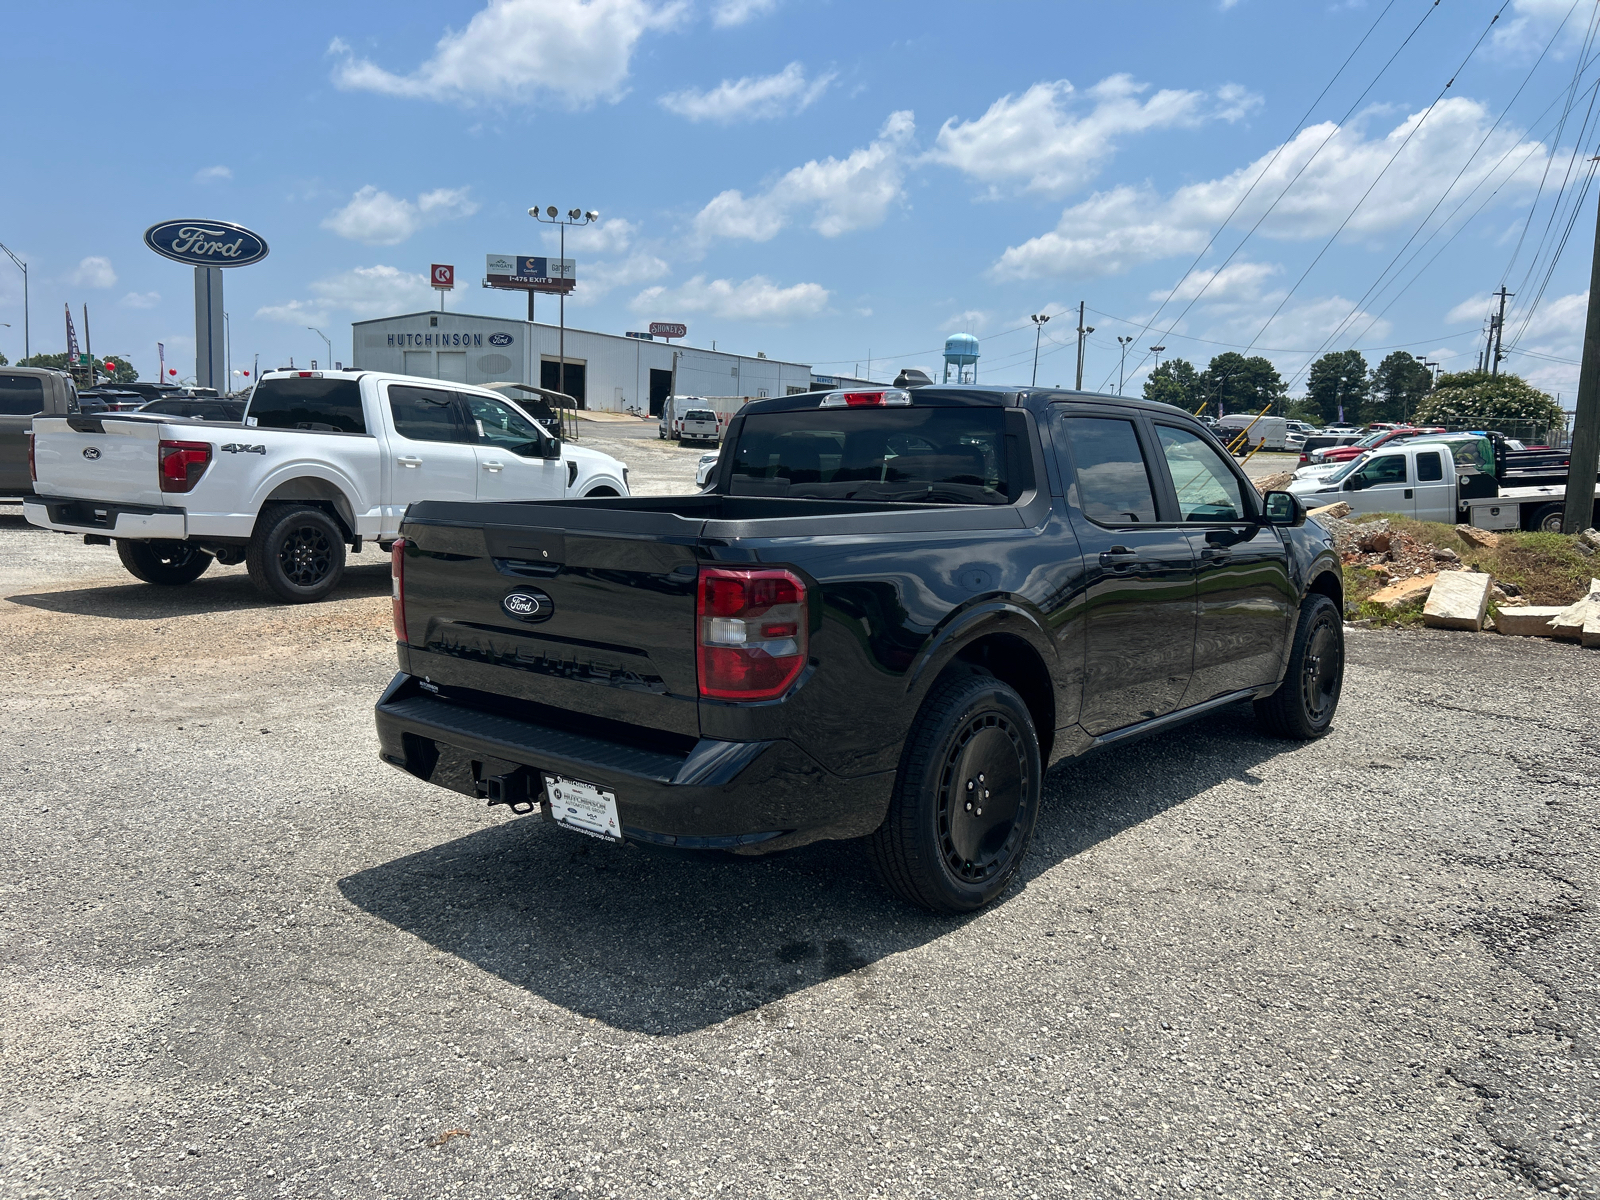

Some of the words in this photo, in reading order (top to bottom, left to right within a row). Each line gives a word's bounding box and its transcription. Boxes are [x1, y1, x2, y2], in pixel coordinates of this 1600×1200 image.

[171, 226, 244, 258] Ford
[551, 263, 572, 272] Garer
[509, 275, 528, 283] I-475
[387, 333, 482, 347] HUTCHINSON
[510, 595, 532, 611] Ford
